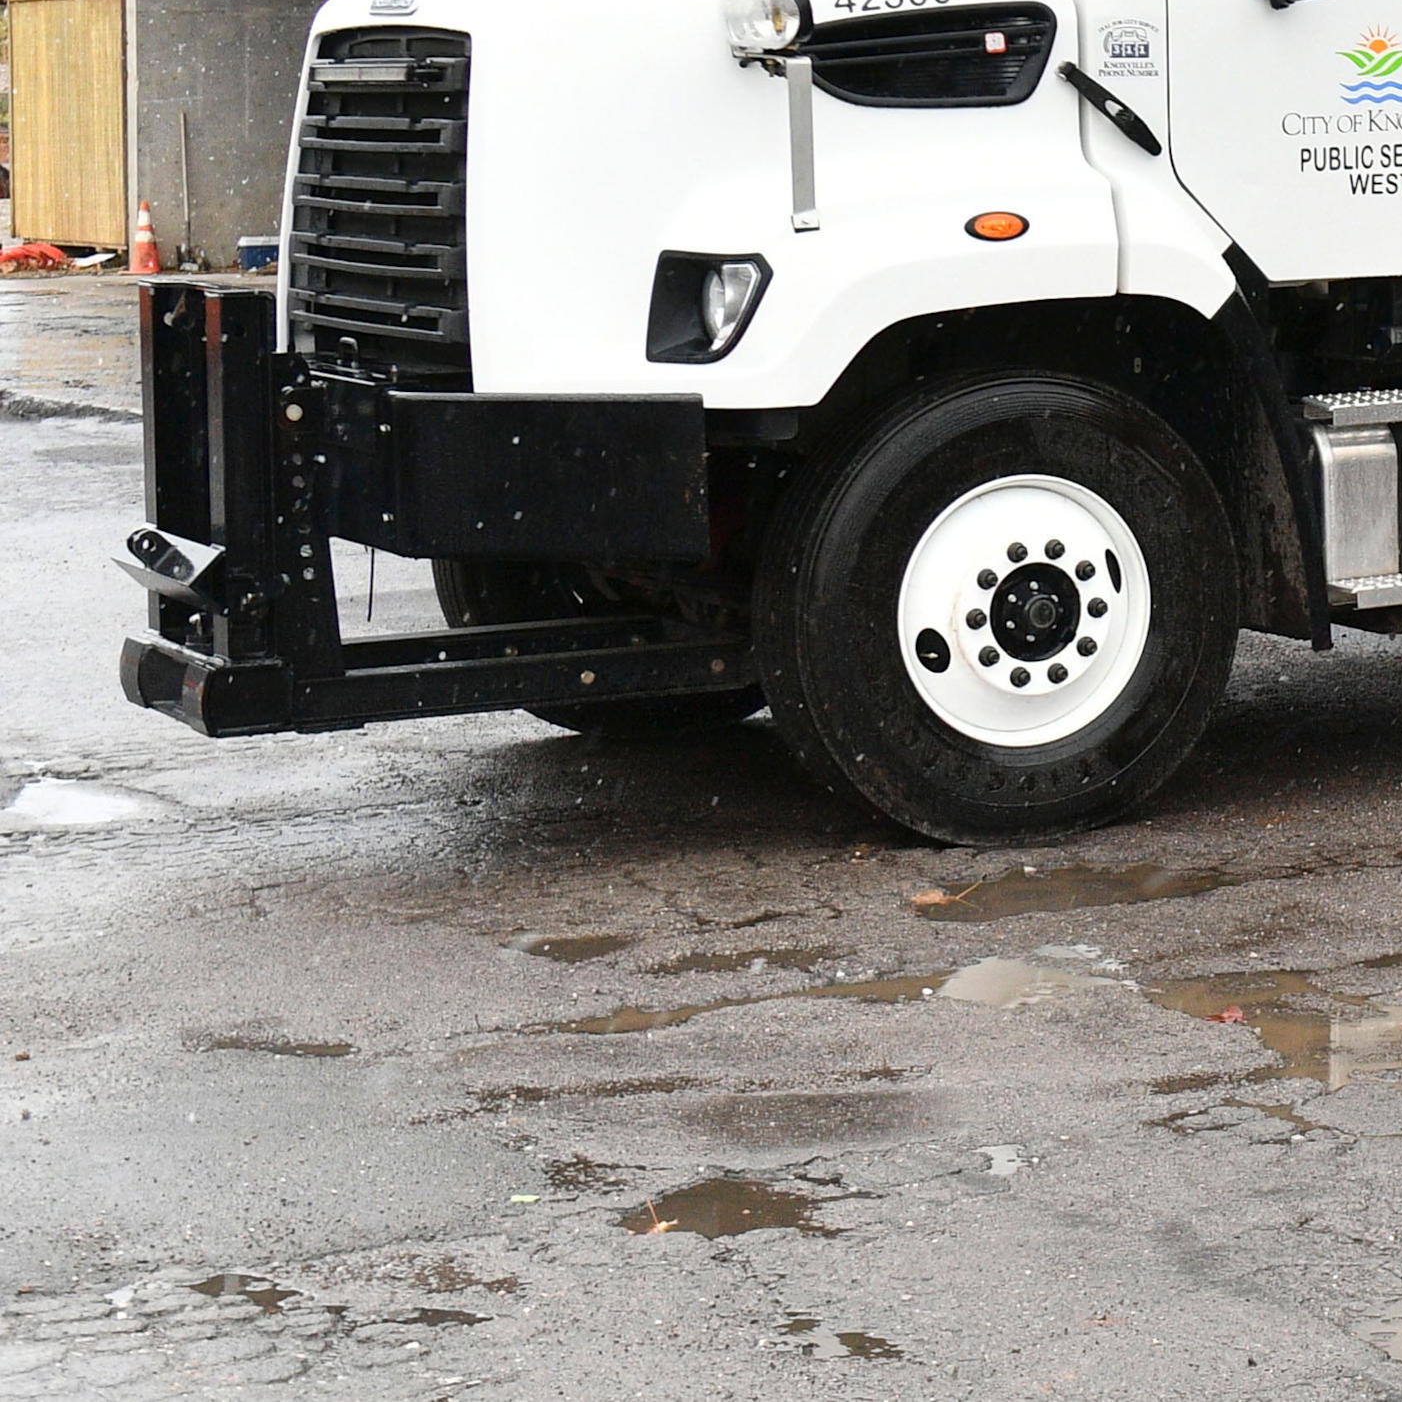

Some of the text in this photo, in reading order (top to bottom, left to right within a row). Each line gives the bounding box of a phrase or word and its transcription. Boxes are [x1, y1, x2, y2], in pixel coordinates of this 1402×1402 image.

[1282, 113, 1332, 136] CITY
[1336, 114, 1364, 133] OF
[1300, 145, 1374, 172] PUBLIC
